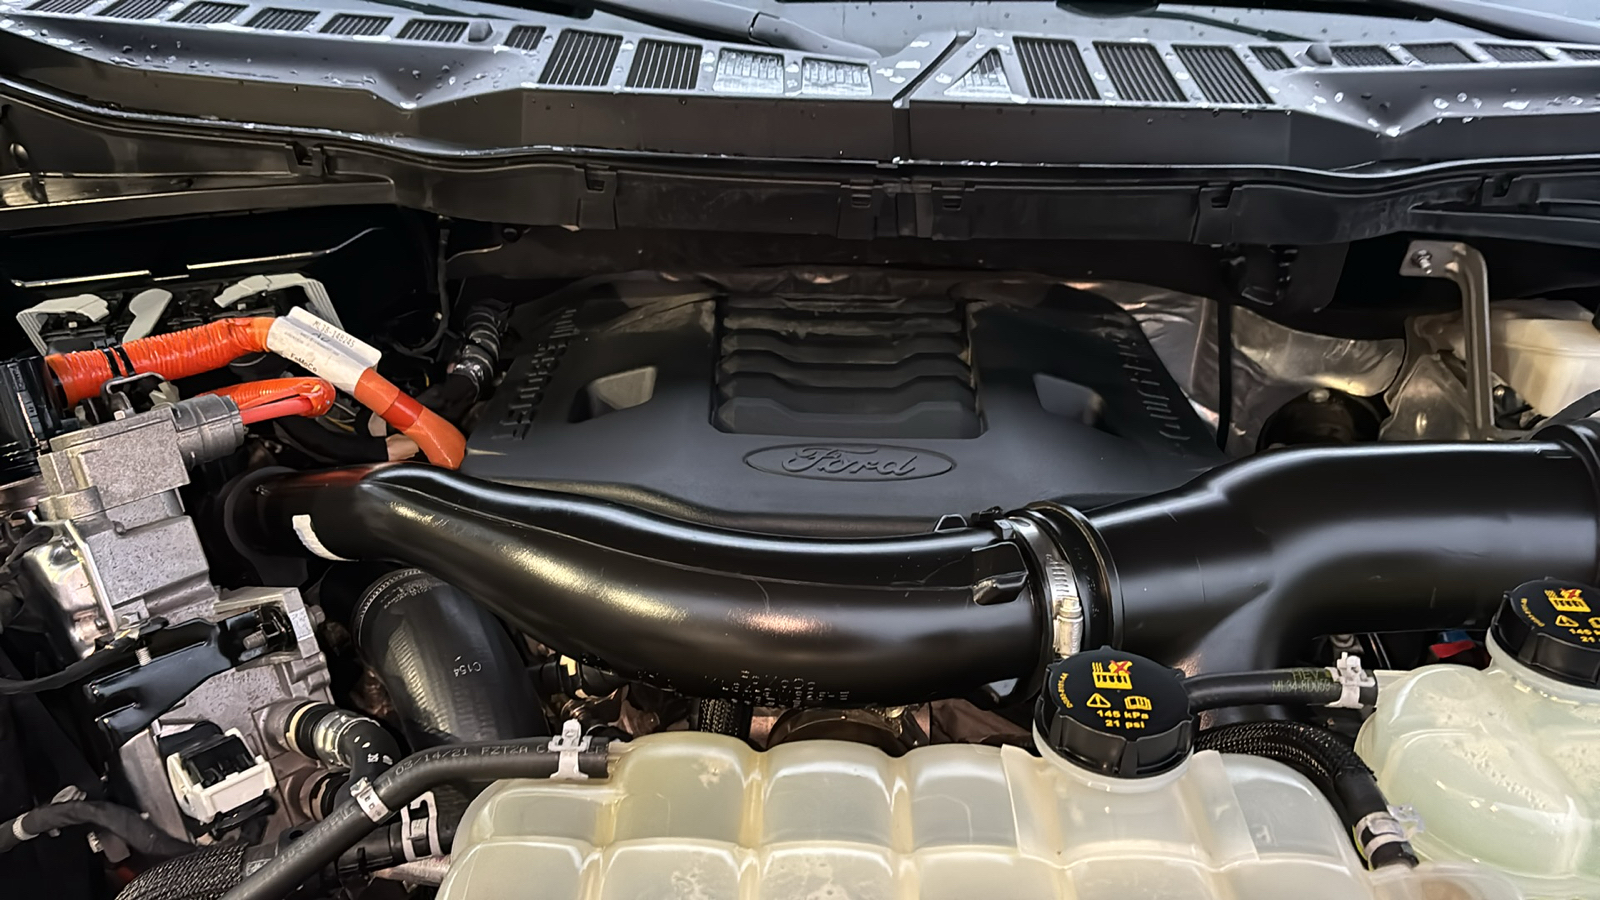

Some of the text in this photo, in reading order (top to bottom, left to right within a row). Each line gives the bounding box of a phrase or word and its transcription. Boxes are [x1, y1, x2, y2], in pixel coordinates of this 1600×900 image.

[781, 447, 919, 476] Ford
[453, 661, 482, 677] C154
[1096, 709, 1150, 720] 145 kPa
[1105, 719, 1145, 729] 21 psi
